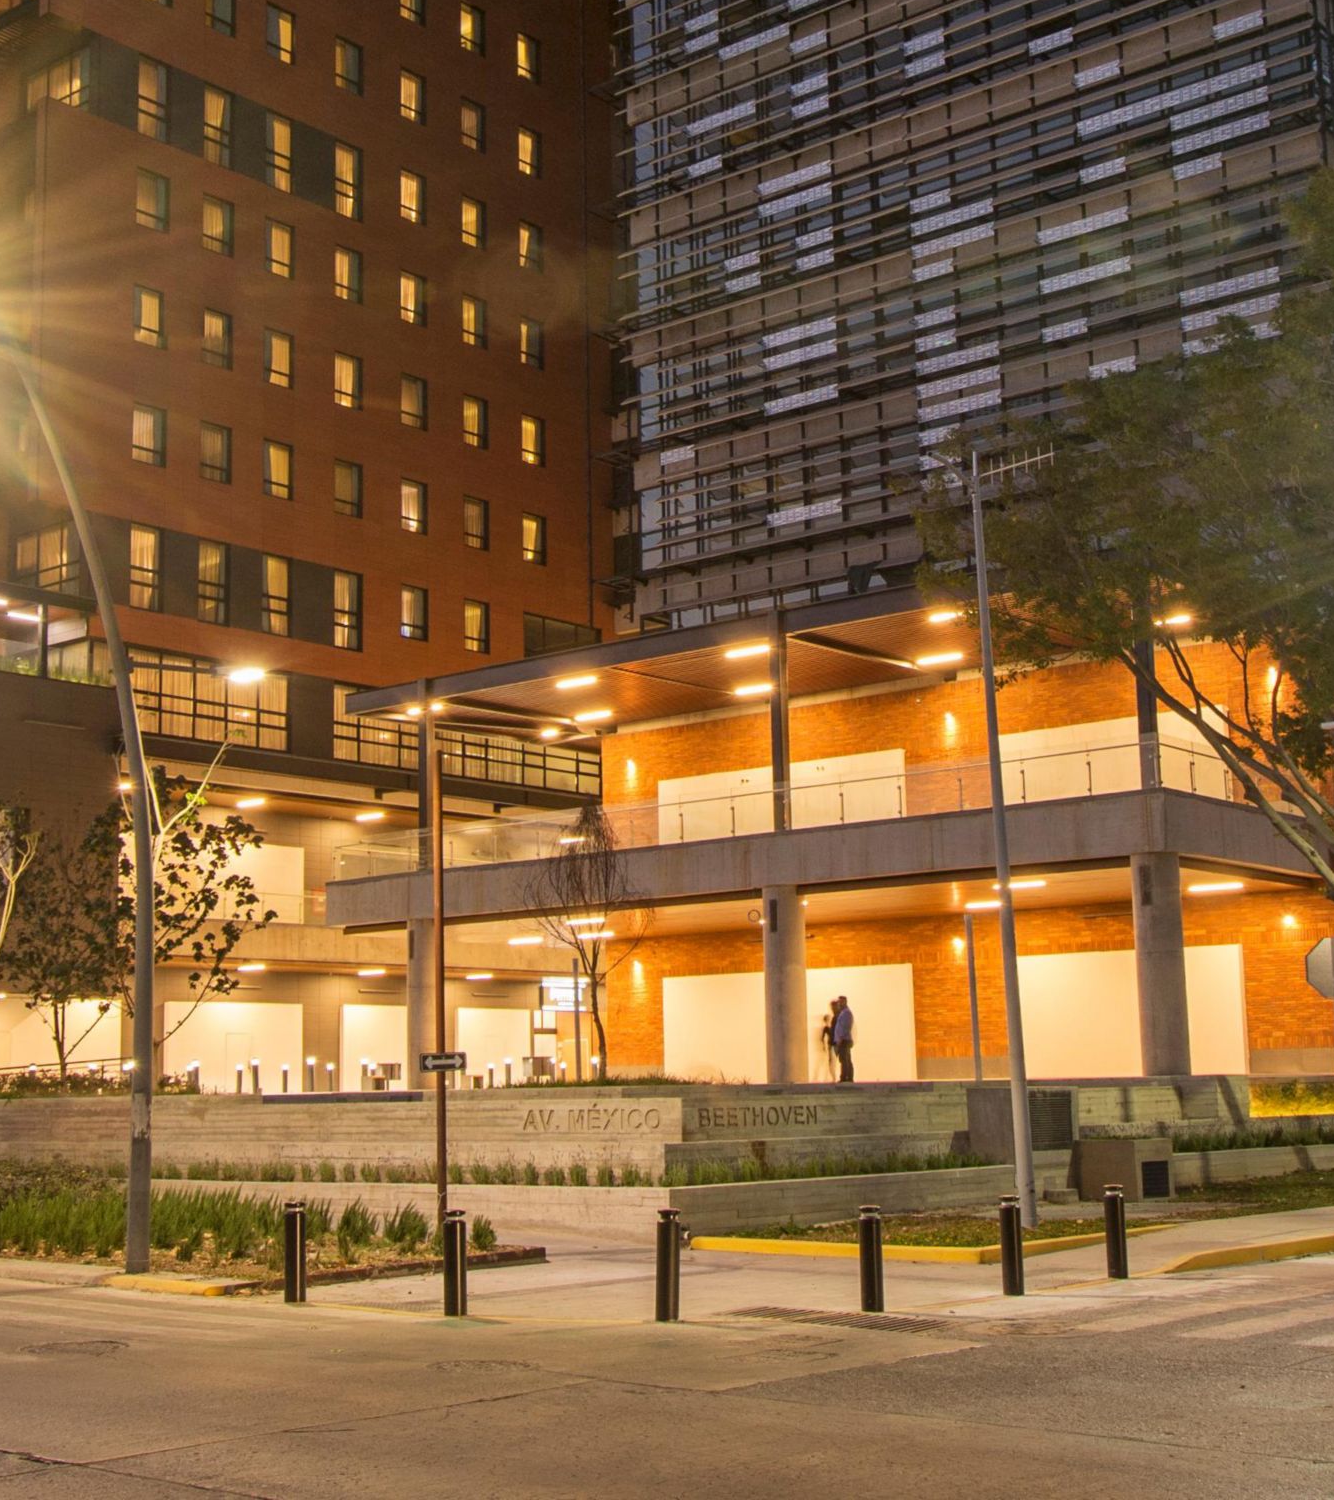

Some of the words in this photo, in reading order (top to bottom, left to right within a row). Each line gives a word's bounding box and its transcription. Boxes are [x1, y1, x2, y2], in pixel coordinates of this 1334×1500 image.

[523, 1108, 560, 1131] AV.
[568, 1103, 661, 1131] MÉXICO
[697, 1104, 818, 1128] BEETHOVEN
